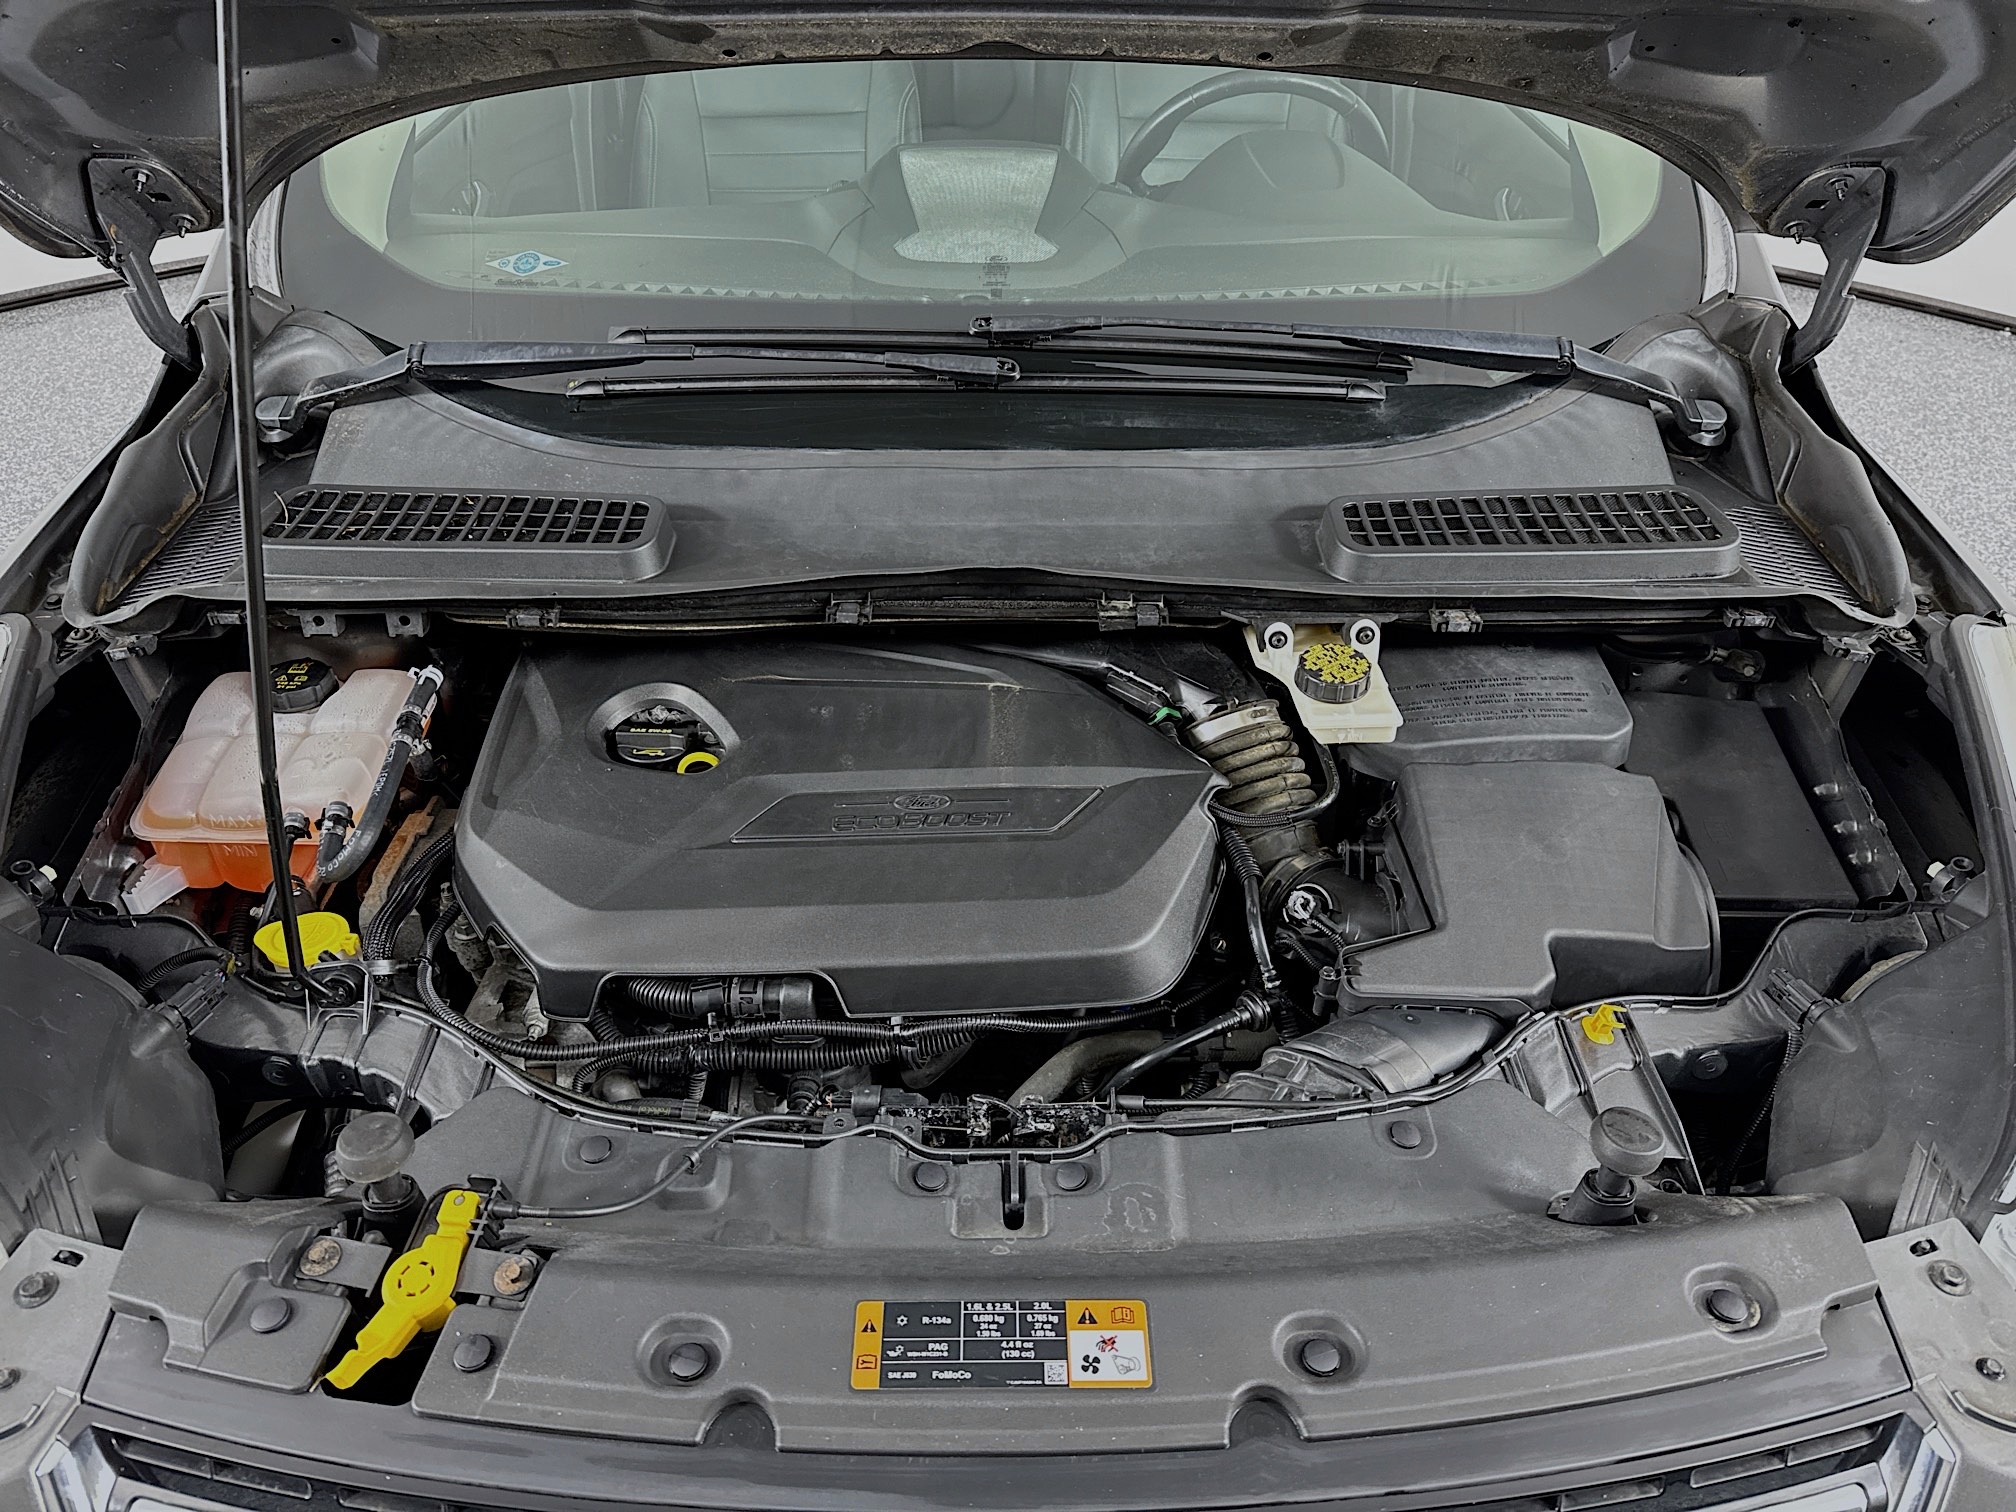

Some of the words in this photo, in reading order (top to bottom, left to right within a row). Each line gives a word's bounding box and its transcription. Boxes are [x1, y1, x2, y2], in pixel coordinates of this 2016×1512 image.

[208, 814, 254, 828] MAX
[222, 844, 257, 857] MIN
[967, 1303, 984, 1311] 1.6L
[986, 1303, 993, 1311] &
[994, 1303, 1013, 1311] 2.5L
[1033, 1302, 1052, 1310] 2.0L
[921, 1316, 951, 1325] R-134a
[928, 1343, 948, 1351] PAG
[1000, 1341, 1014, 1349] 4.4
[1021, 1350, 1035, 1359] cc)
[932, 1370, 972, 1379] FoMoCo
